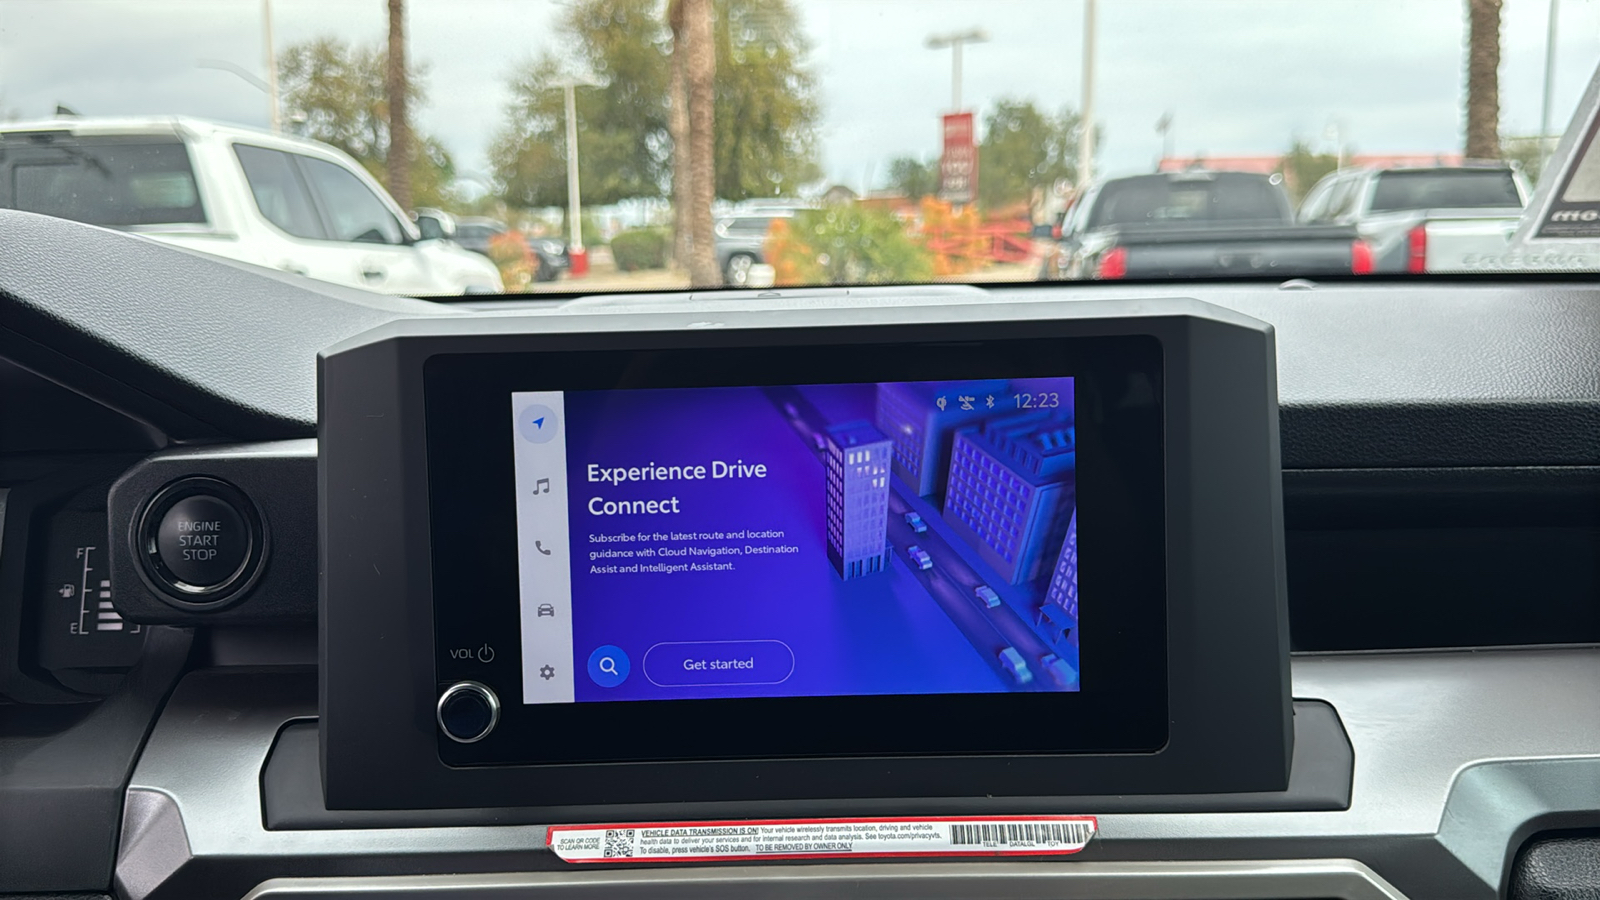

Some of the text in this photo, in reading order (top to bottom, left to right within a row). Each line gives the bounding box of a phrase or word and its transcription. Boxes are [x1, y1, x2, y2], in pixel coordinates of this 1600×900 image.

[1013, 393, 1060, 409] 12:23
[587, 459, 767, 486] Experience Drive
[588, 496, 680, 516] Connect
[178, 521, 221, 531] ENGINE
[179, 535, 219, 546] START
[589, 530, 784, 543] Subscribe for the latest route and location
[77, 548, 84, 559] F
[183, 549, 217, 560] STOP
[589, 545, 799, 560] guidance with Cloud Navigation, Destination
[590, 562, 735, 574] Assist and Intelligent Assistant.
[70, 623, 78, 634] E
[450, 649, 474, 659] VOL
[683, 657, 754, 670] Get started
[641, 829, 668, 837] VEHICLE
[689, 828, 738, 836] TRANSMISSION
[797, 825, 824, 833] wirelessly
[838, 833, 863, 841] analysis.
[648, 846, 670, 854] disable,
[672, 846, 688, 855] press
[716, 844, 729, 852] SOS
[731, 844, 750, 852] button.
